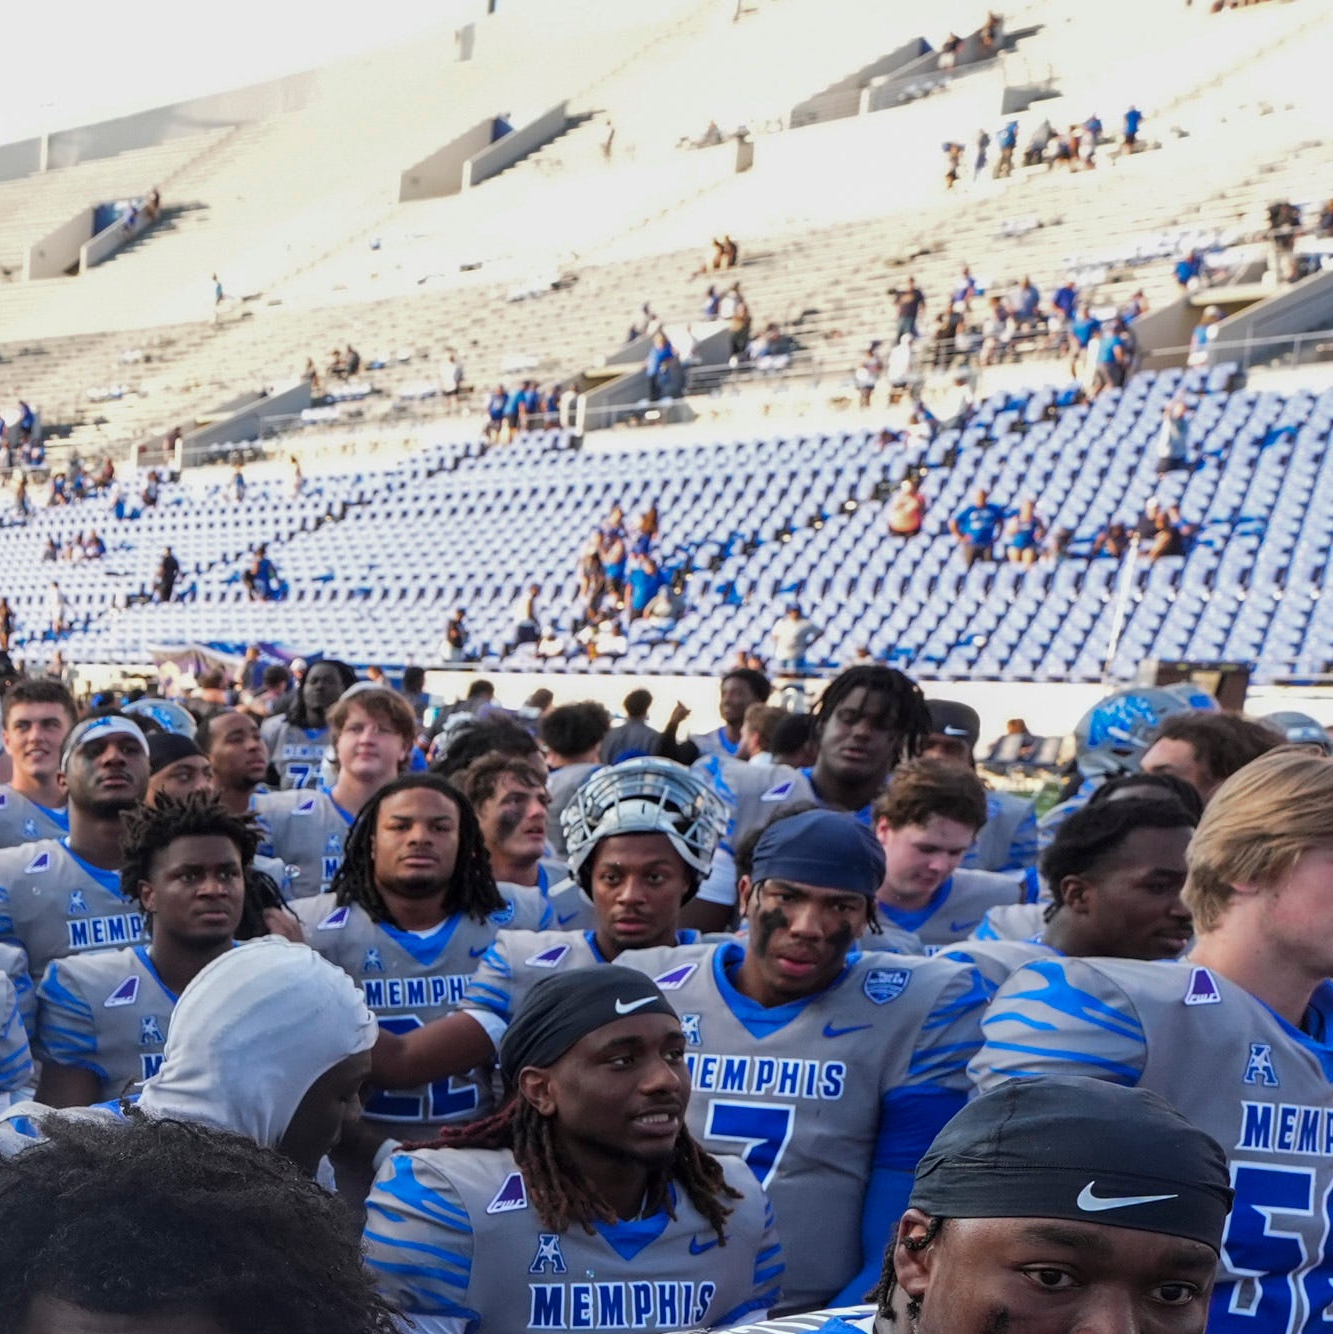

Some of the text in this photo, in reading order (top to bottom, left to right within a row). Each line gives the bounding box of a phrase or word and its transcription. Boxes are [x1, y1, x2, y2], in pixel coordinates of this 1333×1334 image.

[67, 911, 149, 949] MEMP
[361, 974, 473, 1009] MEMPH
[703, 1099, 796, 1192] 7
[527, 1280, 717, 1330] MEMPHIS
